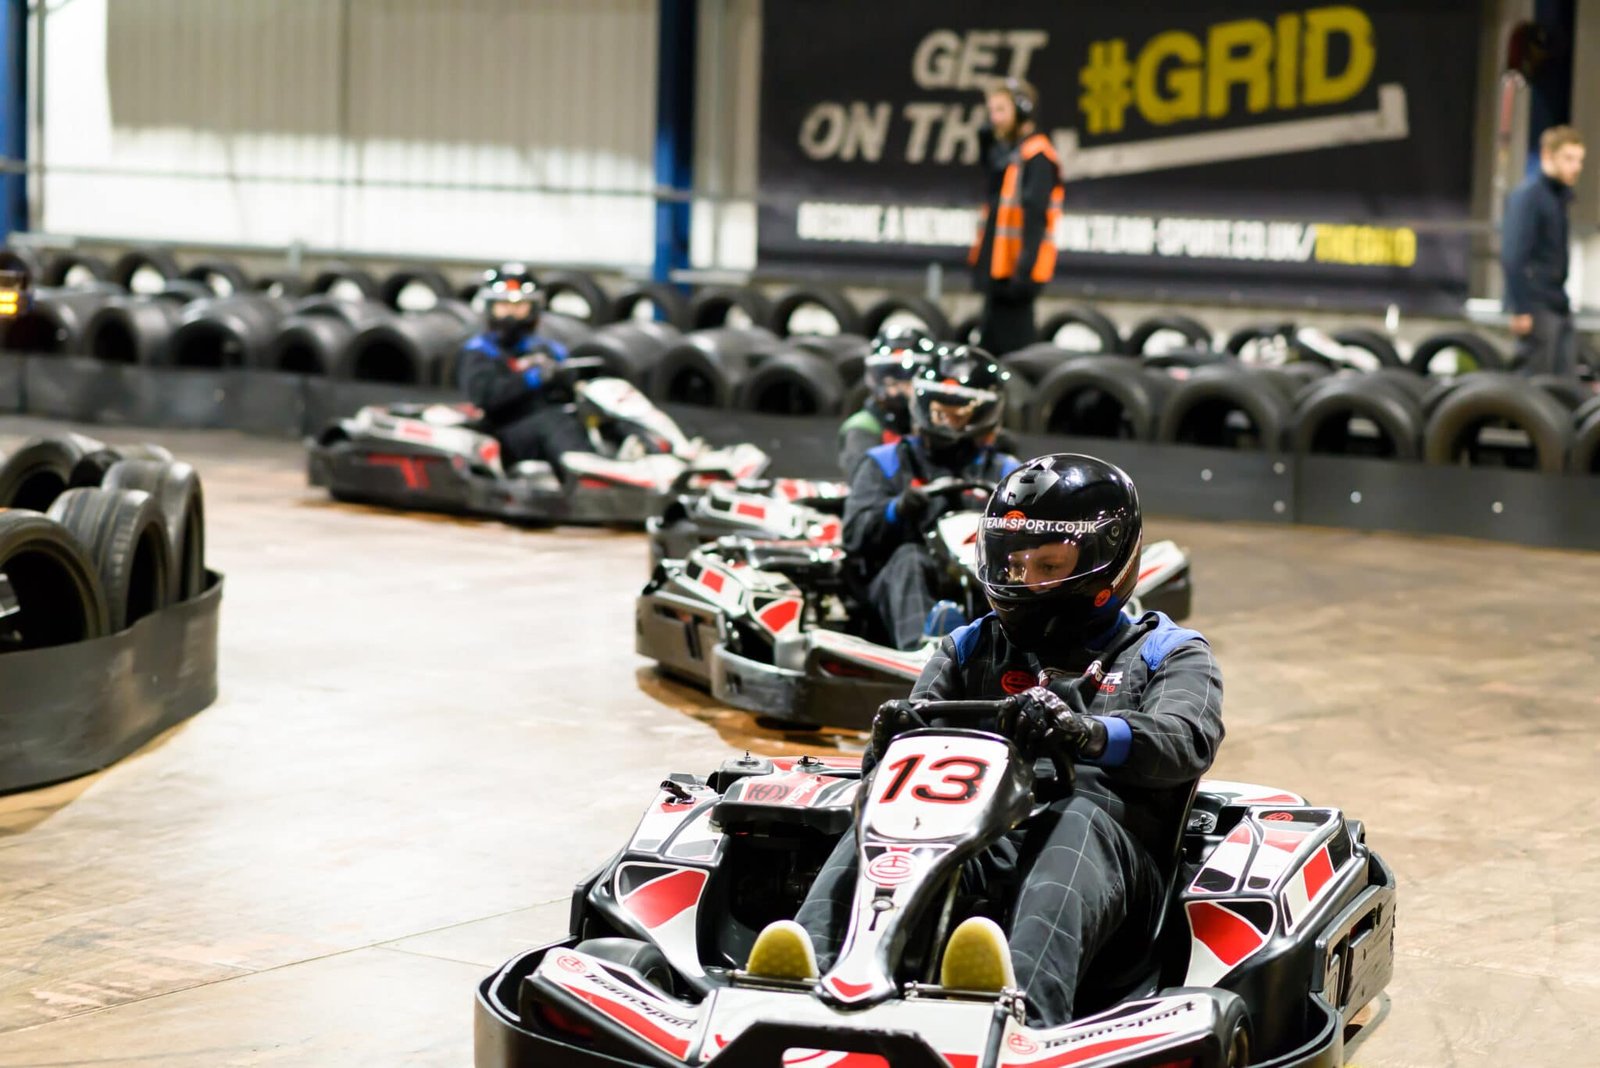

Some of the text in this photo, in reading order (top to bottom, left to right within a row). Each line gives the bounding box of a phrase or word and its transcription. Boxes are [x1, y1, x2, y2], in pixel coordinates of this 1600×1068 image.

[913, 29, 1048, 91] GET
[1079, 6, 1377, 136] #GRID
[799, 102, 986, 164] ON TH
[983, 517, 1097, 534] TEAM-SPORT.CO.UK
[879, 754, 990, 804] 13
